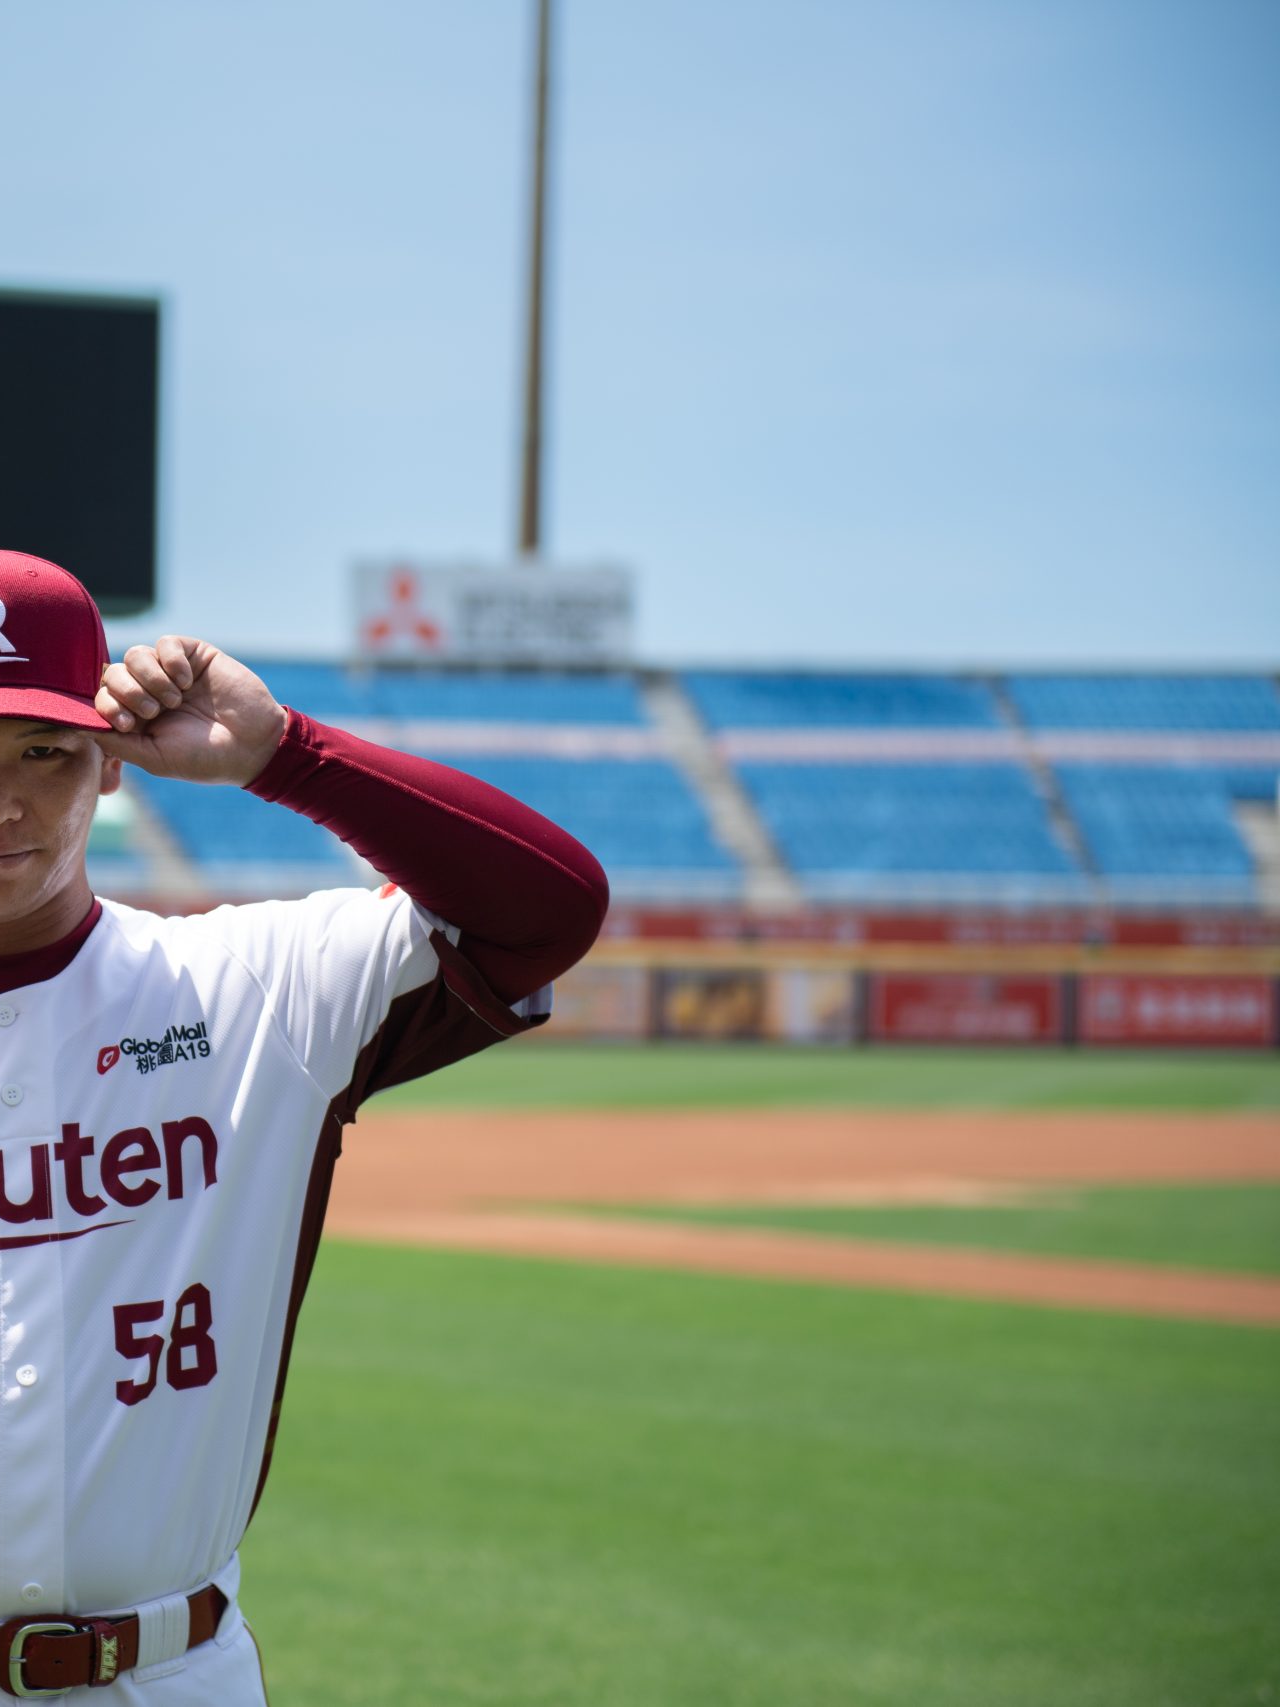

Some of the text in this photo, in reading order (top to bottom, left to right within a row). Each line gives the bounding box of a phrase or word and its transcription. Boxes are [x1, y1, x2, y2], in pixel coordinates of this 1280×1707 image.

[171, 1021, 208, 1042] Mall
[113, 1282, 218, 1406] 58
[99, 1633, 117, 1680] TPX
